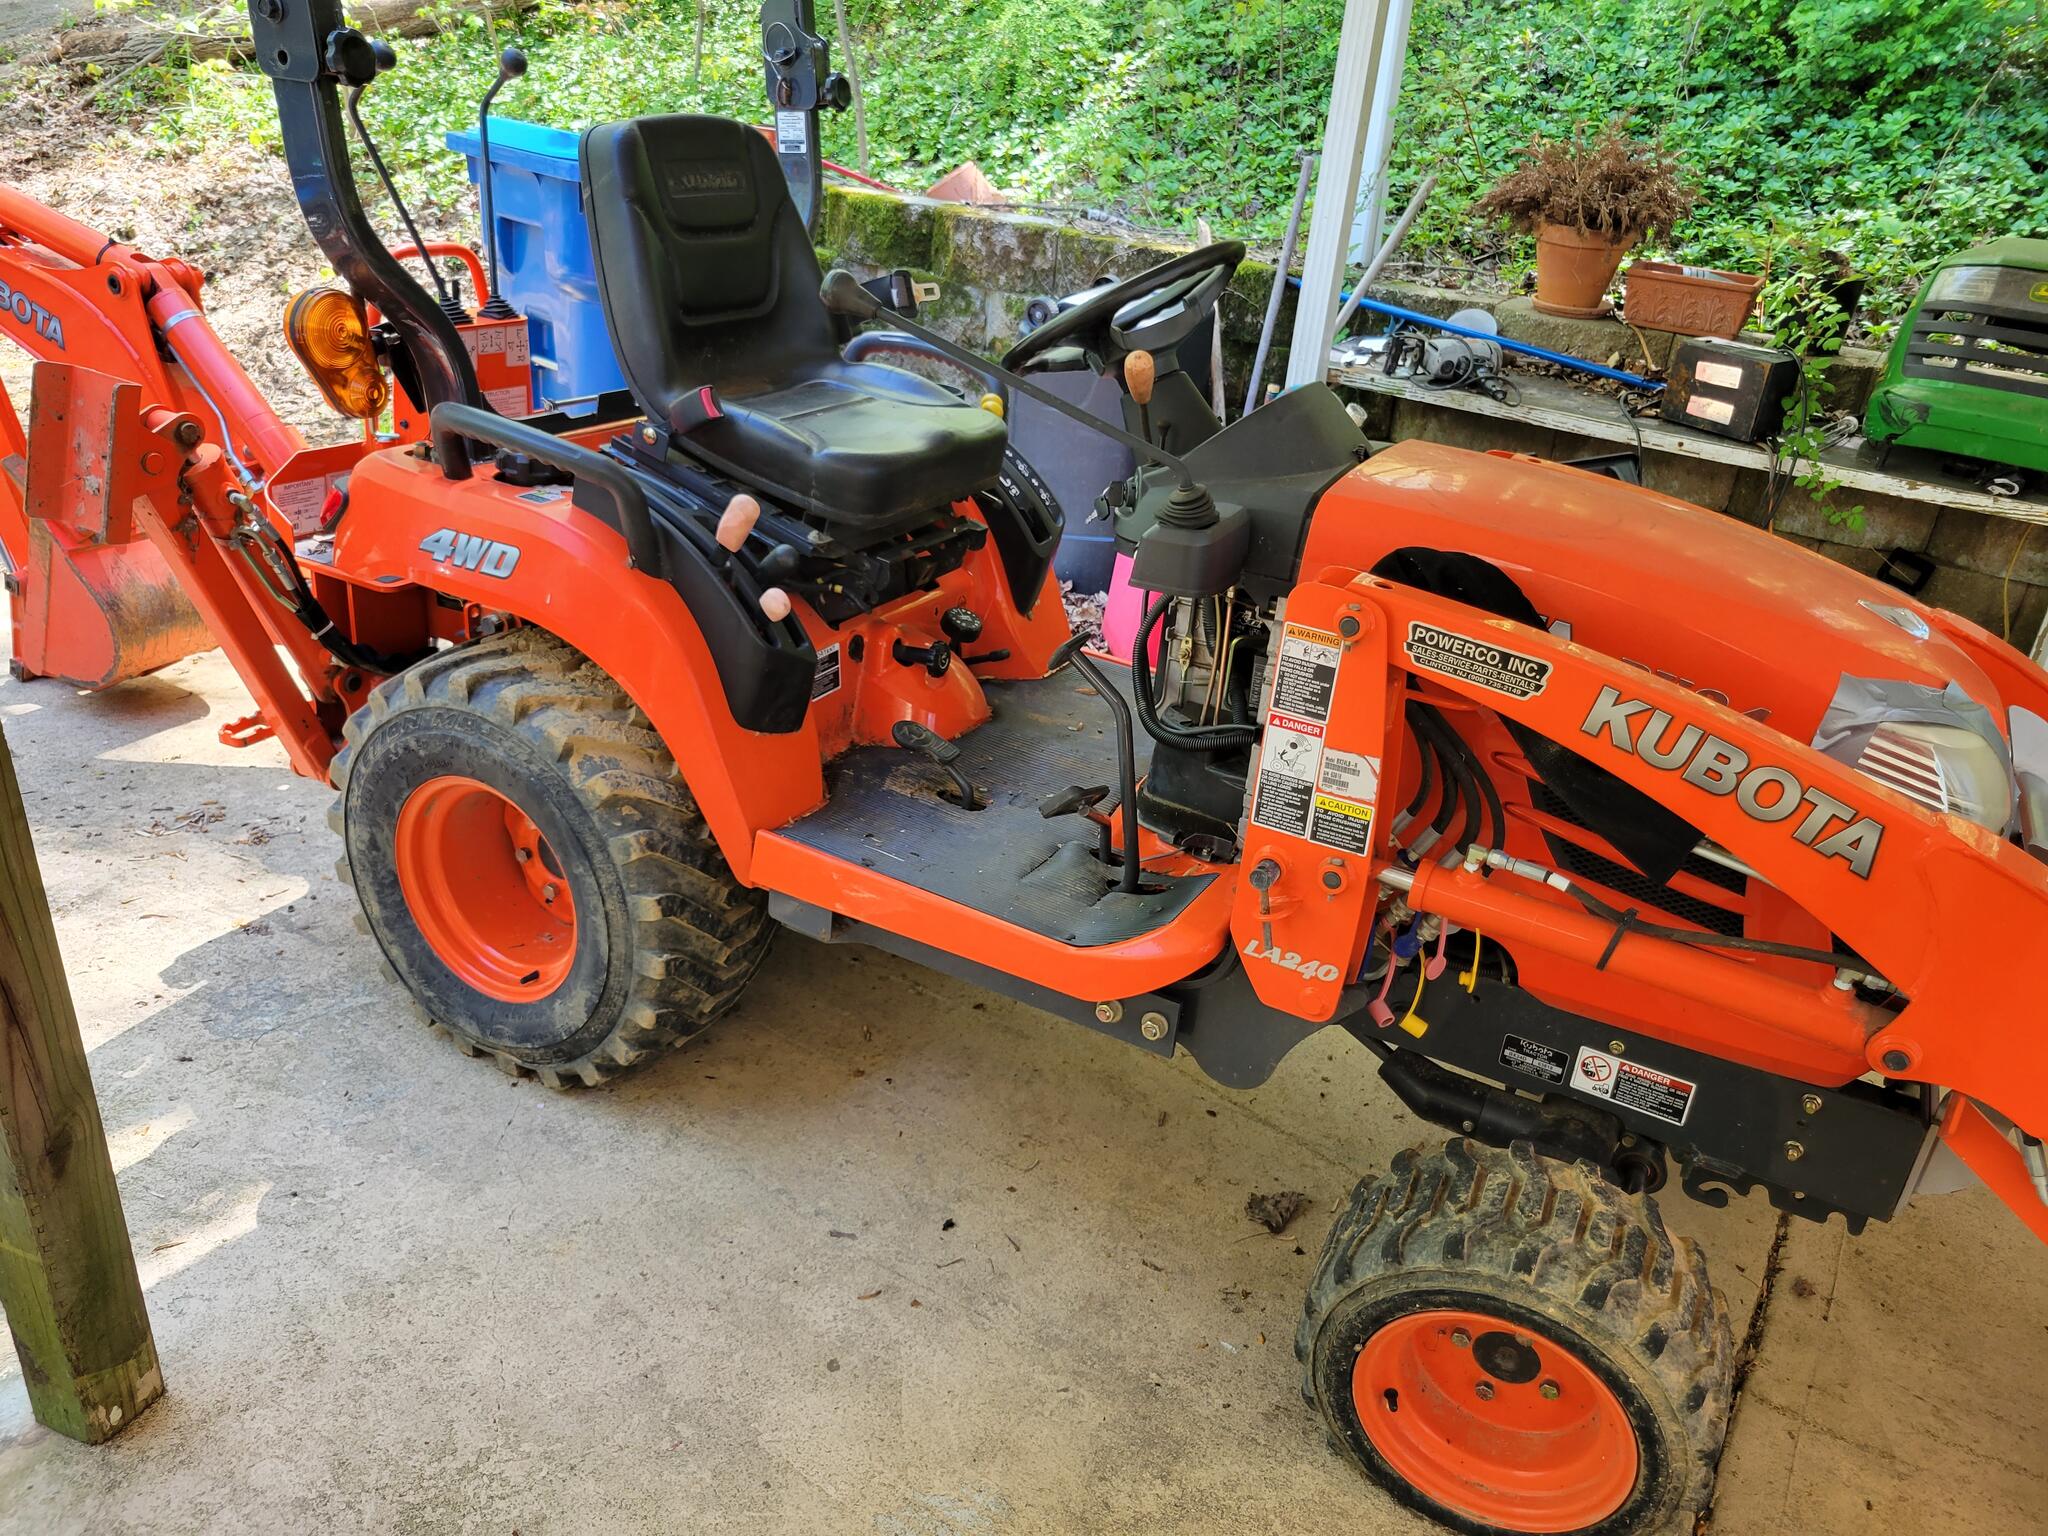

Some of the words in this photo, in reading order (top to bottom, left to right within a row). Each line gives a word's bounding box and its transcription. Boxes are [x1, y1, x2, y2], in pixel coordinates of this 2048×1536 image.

[418, 527, 522, 580] 4WD
[1297, 629, 1340, 646] WARNING
[1414, 627, 1503, 669] POWERCO,
[1507, 657, 1540, 680] INC.
[1456, 670, 1468, 678] NJ
[1282, 719, 1321, 736] DANGER
[1580, 684, 1886, 881] KUBOTA
[1315, 812, 1331, 820] FROM
[1328, 800, 1368, 816] CAUTION
[1327, 810, 1344, 818] AVOID
[1348, 817, 1368, 825] INJURY
[1243, 939, 1339, 981] LA240
[1520, 1040, 1552, 1057] Kubota
[1523, 1049, 1547, 1059] TRACTOR
[1631, 1066, 1671, 1085] DANGER
